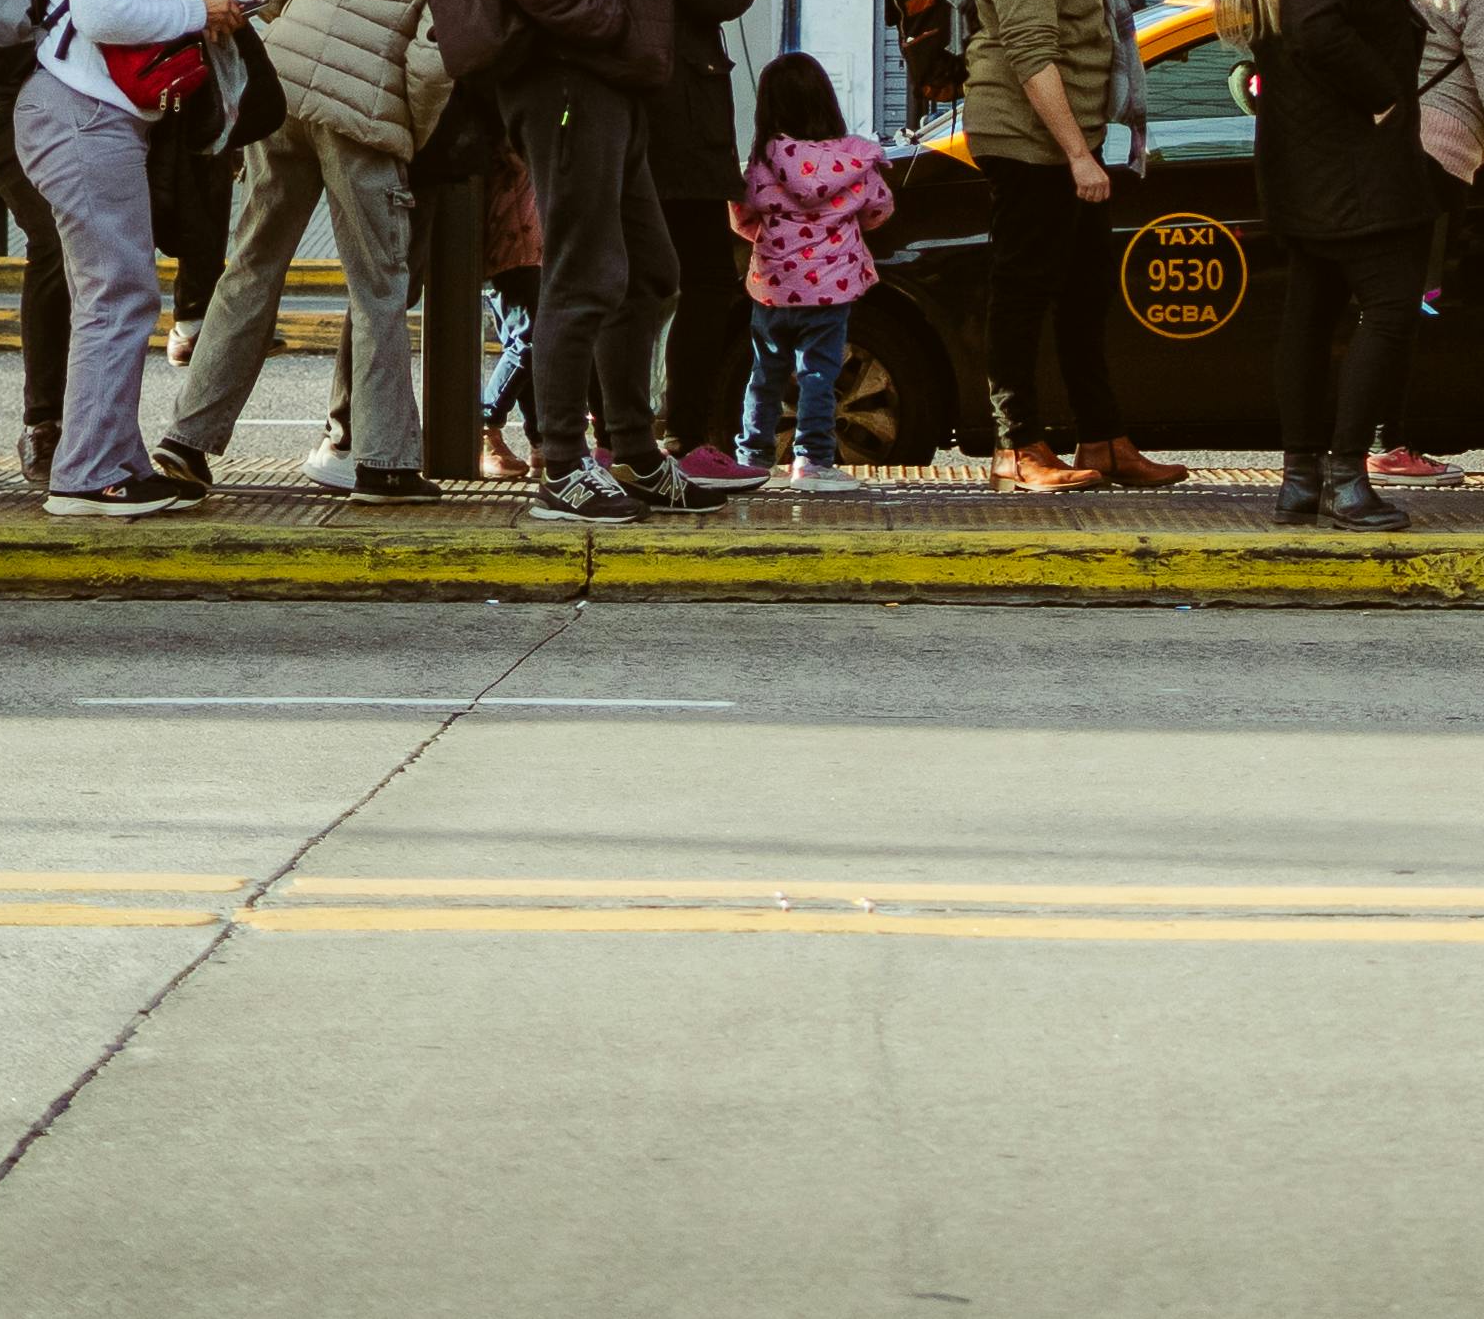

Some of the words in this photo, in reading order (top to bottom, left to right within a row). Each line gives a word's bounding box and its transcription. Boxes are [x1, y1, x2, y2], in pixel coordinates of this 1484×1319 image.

[1155, 228, 1214, 246] TAXI
[1148, 259, 1224, 292] 9530
[1147, 304, 1219, 323] GCBA
